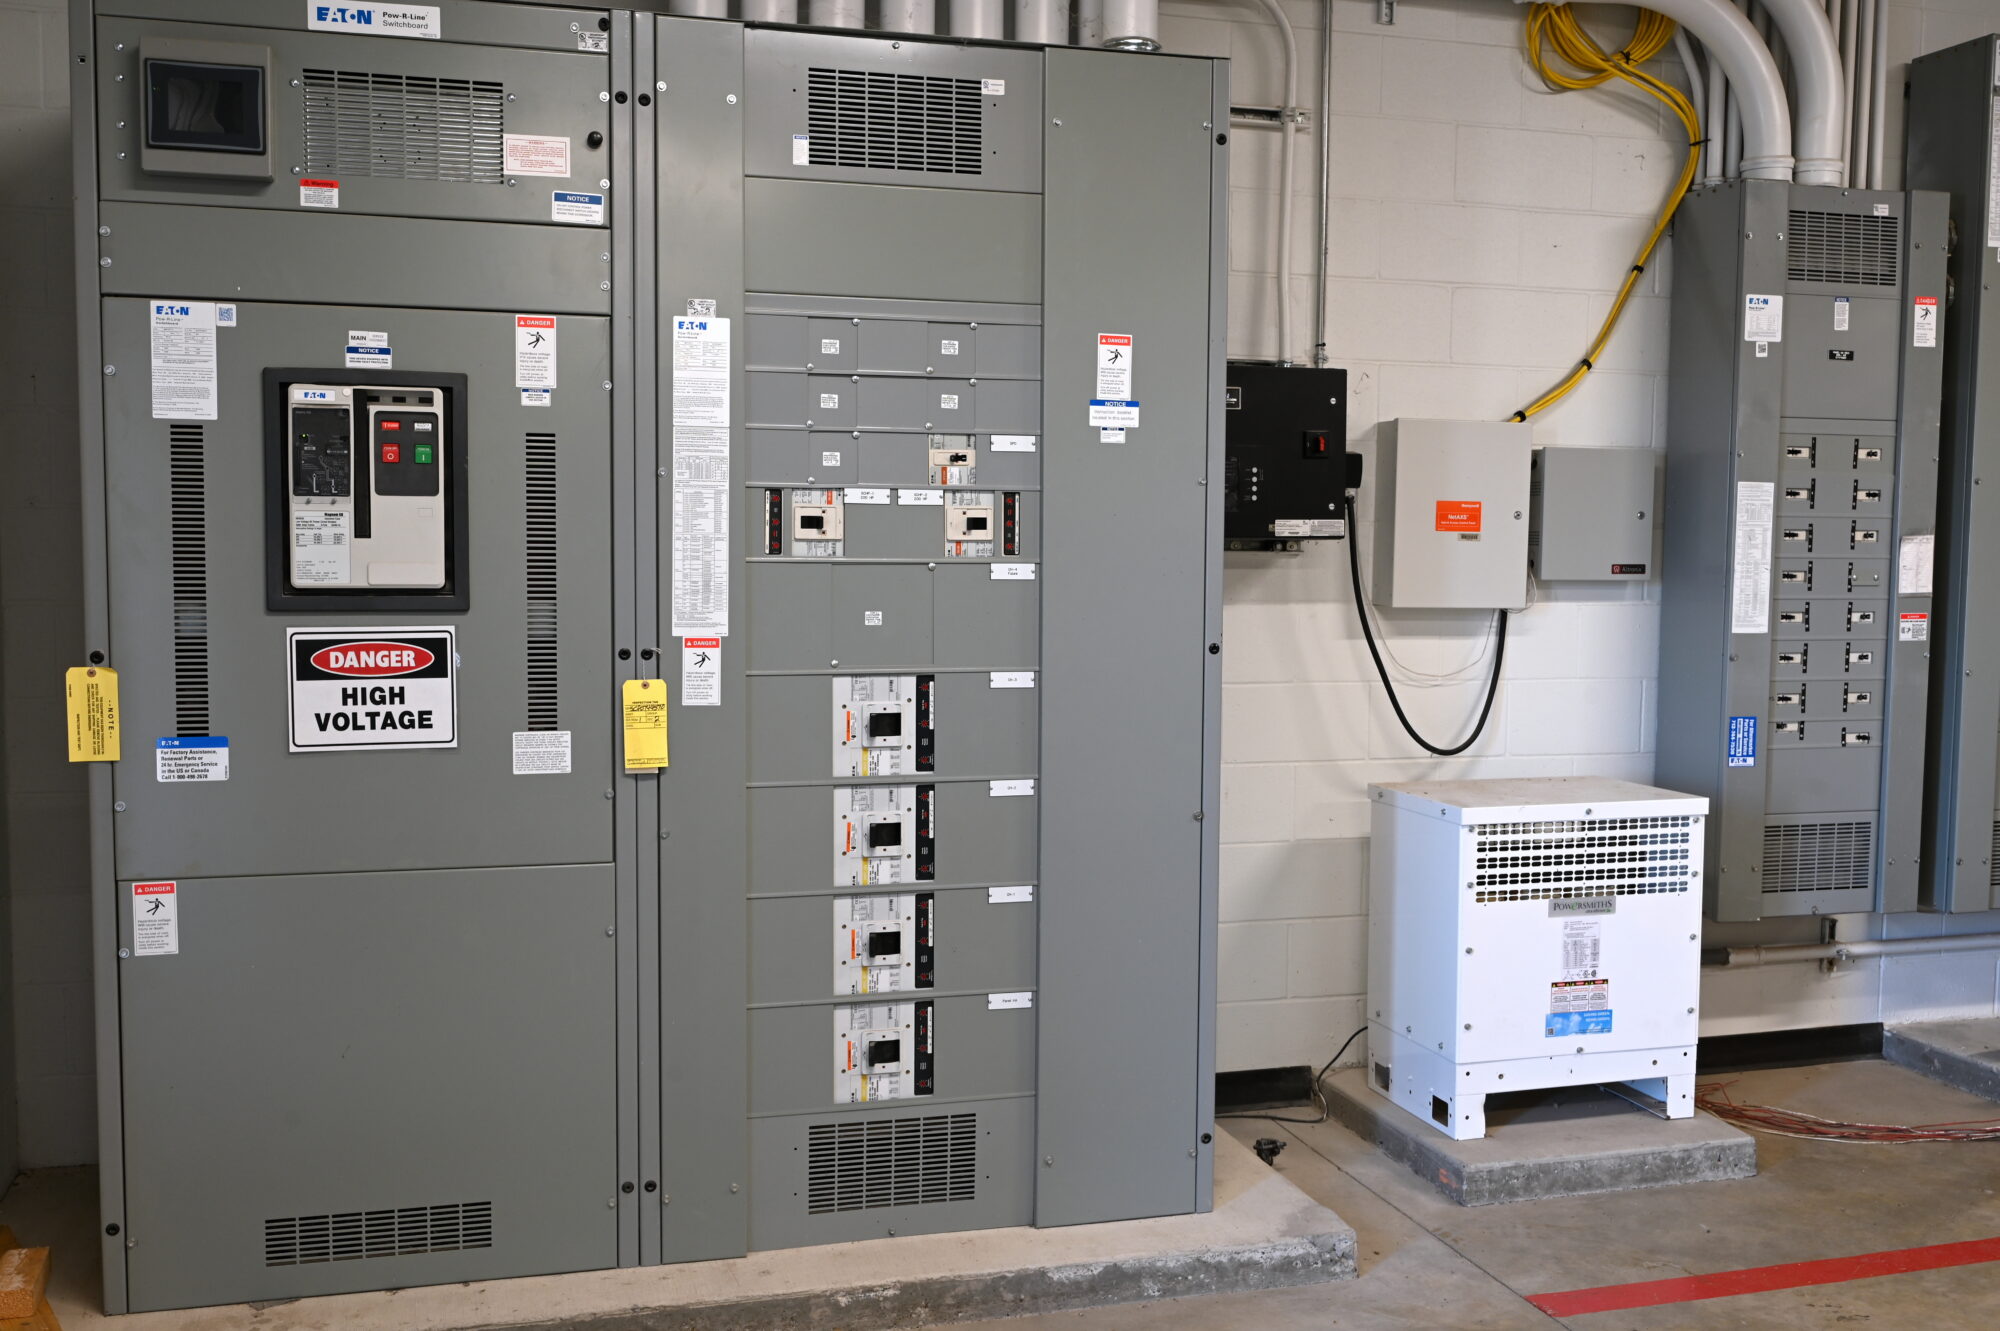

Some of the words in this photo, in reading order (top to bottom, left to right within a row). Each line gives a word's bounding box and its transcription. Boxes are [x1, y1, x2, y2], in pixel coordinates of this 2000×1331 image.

[316, 6, 372, 24] EATON
[382, 20, 428, 30] Switchboard
[156, 306, 189, 316] EATON
[678, 321, 707, 330] EATON
[329, 650, 416, 668] DANGER
[341, 686, 405, 706] HIGH
[314, 710, 433, 731] VOLTAGE
